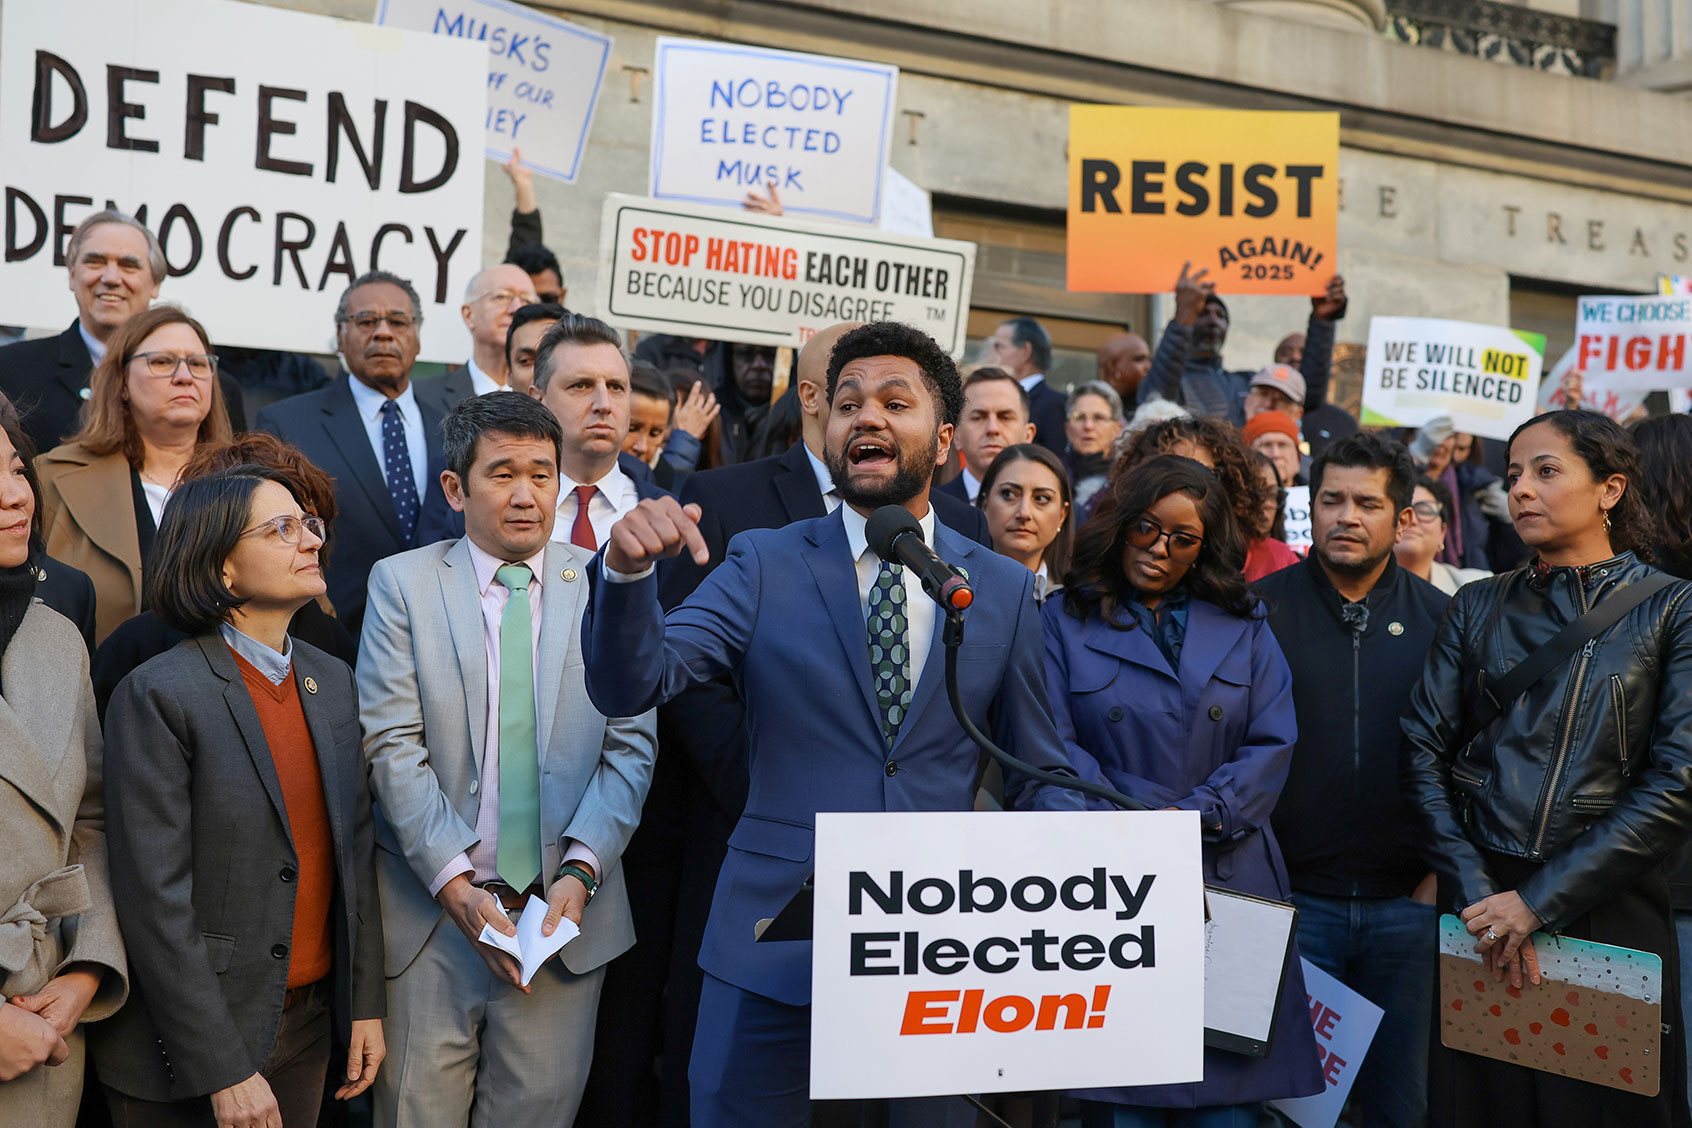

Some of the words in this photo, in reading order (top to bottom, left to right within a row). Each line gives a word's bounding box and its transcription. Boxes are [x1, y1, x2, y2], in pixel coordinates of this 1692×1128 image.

[433, 8, 551, 72] MUSK'S
[487, 71, 508, 91] FF
[514, 81, 554, 109] OUR
[711, 78, 853, 115] NOBODY
[31, 50, 459, 193] DEFEND
[701, 118, 841, 154] ELECTED
[717, 160, 804, 192] MUSK
[1081, 158, 1324, 219] RESIST
[5, 186, 468, 304] DEOCRACY
[1218, 236, 1324, 271] AGAIN!
[1503, 204, 1689, 263] TREAS
[631, 227, 699, 267] STOP
[705, 237, 798, 281] HATING
[805, 251, 868, 290] EACH
[875, 260, 949, 300] OTHER
[1241, 264, 1294, 281] 2025
[627, 270, 731, 307] BECAUSE
[739, 283, 782, 312] YOU
[788, 290, 895, 322] DISAGREE
[926, 306, 946, 321] TM
[1582, 303, 1613, 323] WE
[1617, 302, 1690, 324] CHOOSE
[1385, 342, 1417, 363] WE
[1426, 343, 1477, 369] WILL
[1485, 351, 1527, 377] NOT
[1578, 334, 1692, 371] FIGH
[1381, 368, 1407, 389] BE
[1416, 369, 1522, 404] SILENCED
[848, 867, 1157, 921] Nobody
[849, 925, 1156, 976] Elected
[899, 984, 1112, 1036] Elon!
